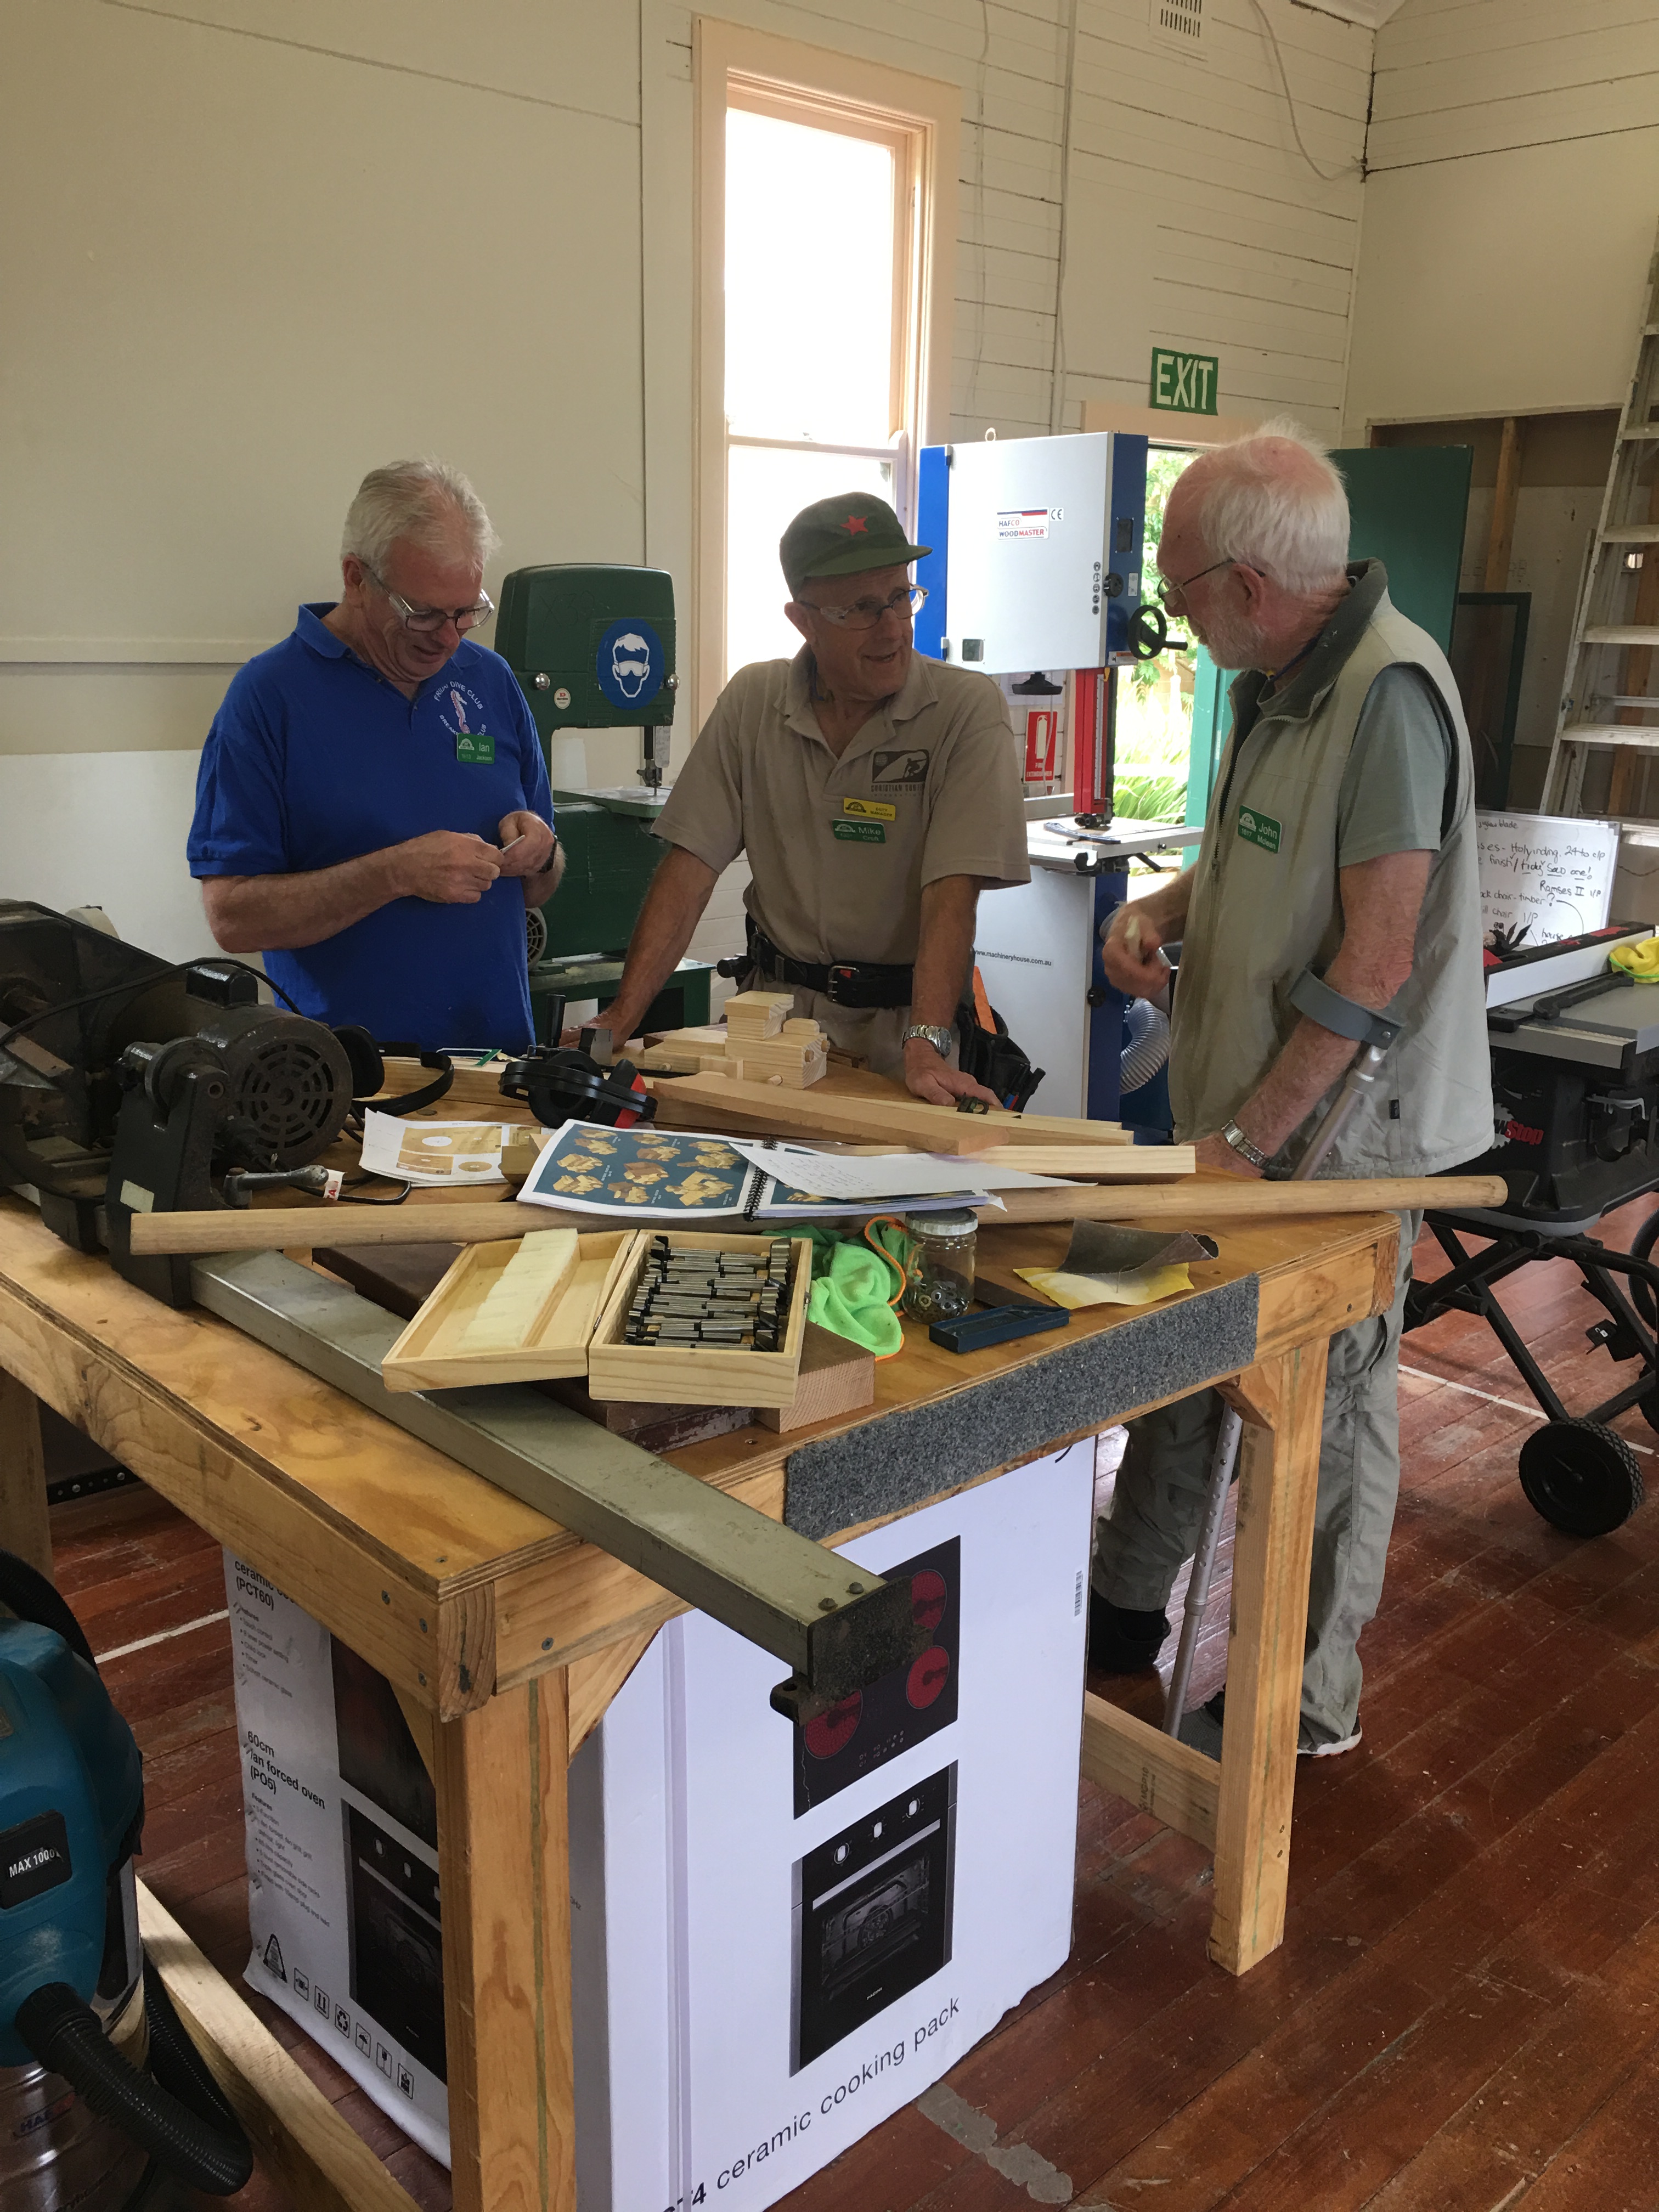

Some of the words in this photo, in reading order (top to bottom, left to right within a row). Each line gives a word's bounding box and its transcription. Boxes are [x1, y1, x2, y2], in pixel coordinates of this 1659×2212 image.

[1156, 354, 1214, 410] EXIT
[999, 529, 1045, 537] WOODMASTER
[450, 681, 466, 691] DIVE
[467, 690, 483, 709] CLUB
[478, 742, 490, 752] Ian
[858, 827, 881, 836] Mike
[1259, 823, 1277, 839] John
[1499, 819, 1518, 829] blade
[1540, 880, 1572, 895] Ramses
[1492, 908, 1513, 918] chair
[236, 1575, 274, 1611] (PCT60)
[247, 1731, 274, 1757] 60cm
[267, 1760, 298, 1791] forced
[302, 1786, 325, 1809] oven
[8, 1857, 32, 1878] MAX
[33, 1849, 62, 1866] 1000
[716, 2111, 811, 2190] ceramic
[820, 2040, 905, 2115] cooking
[914, 1995, 960, 2052] pack
